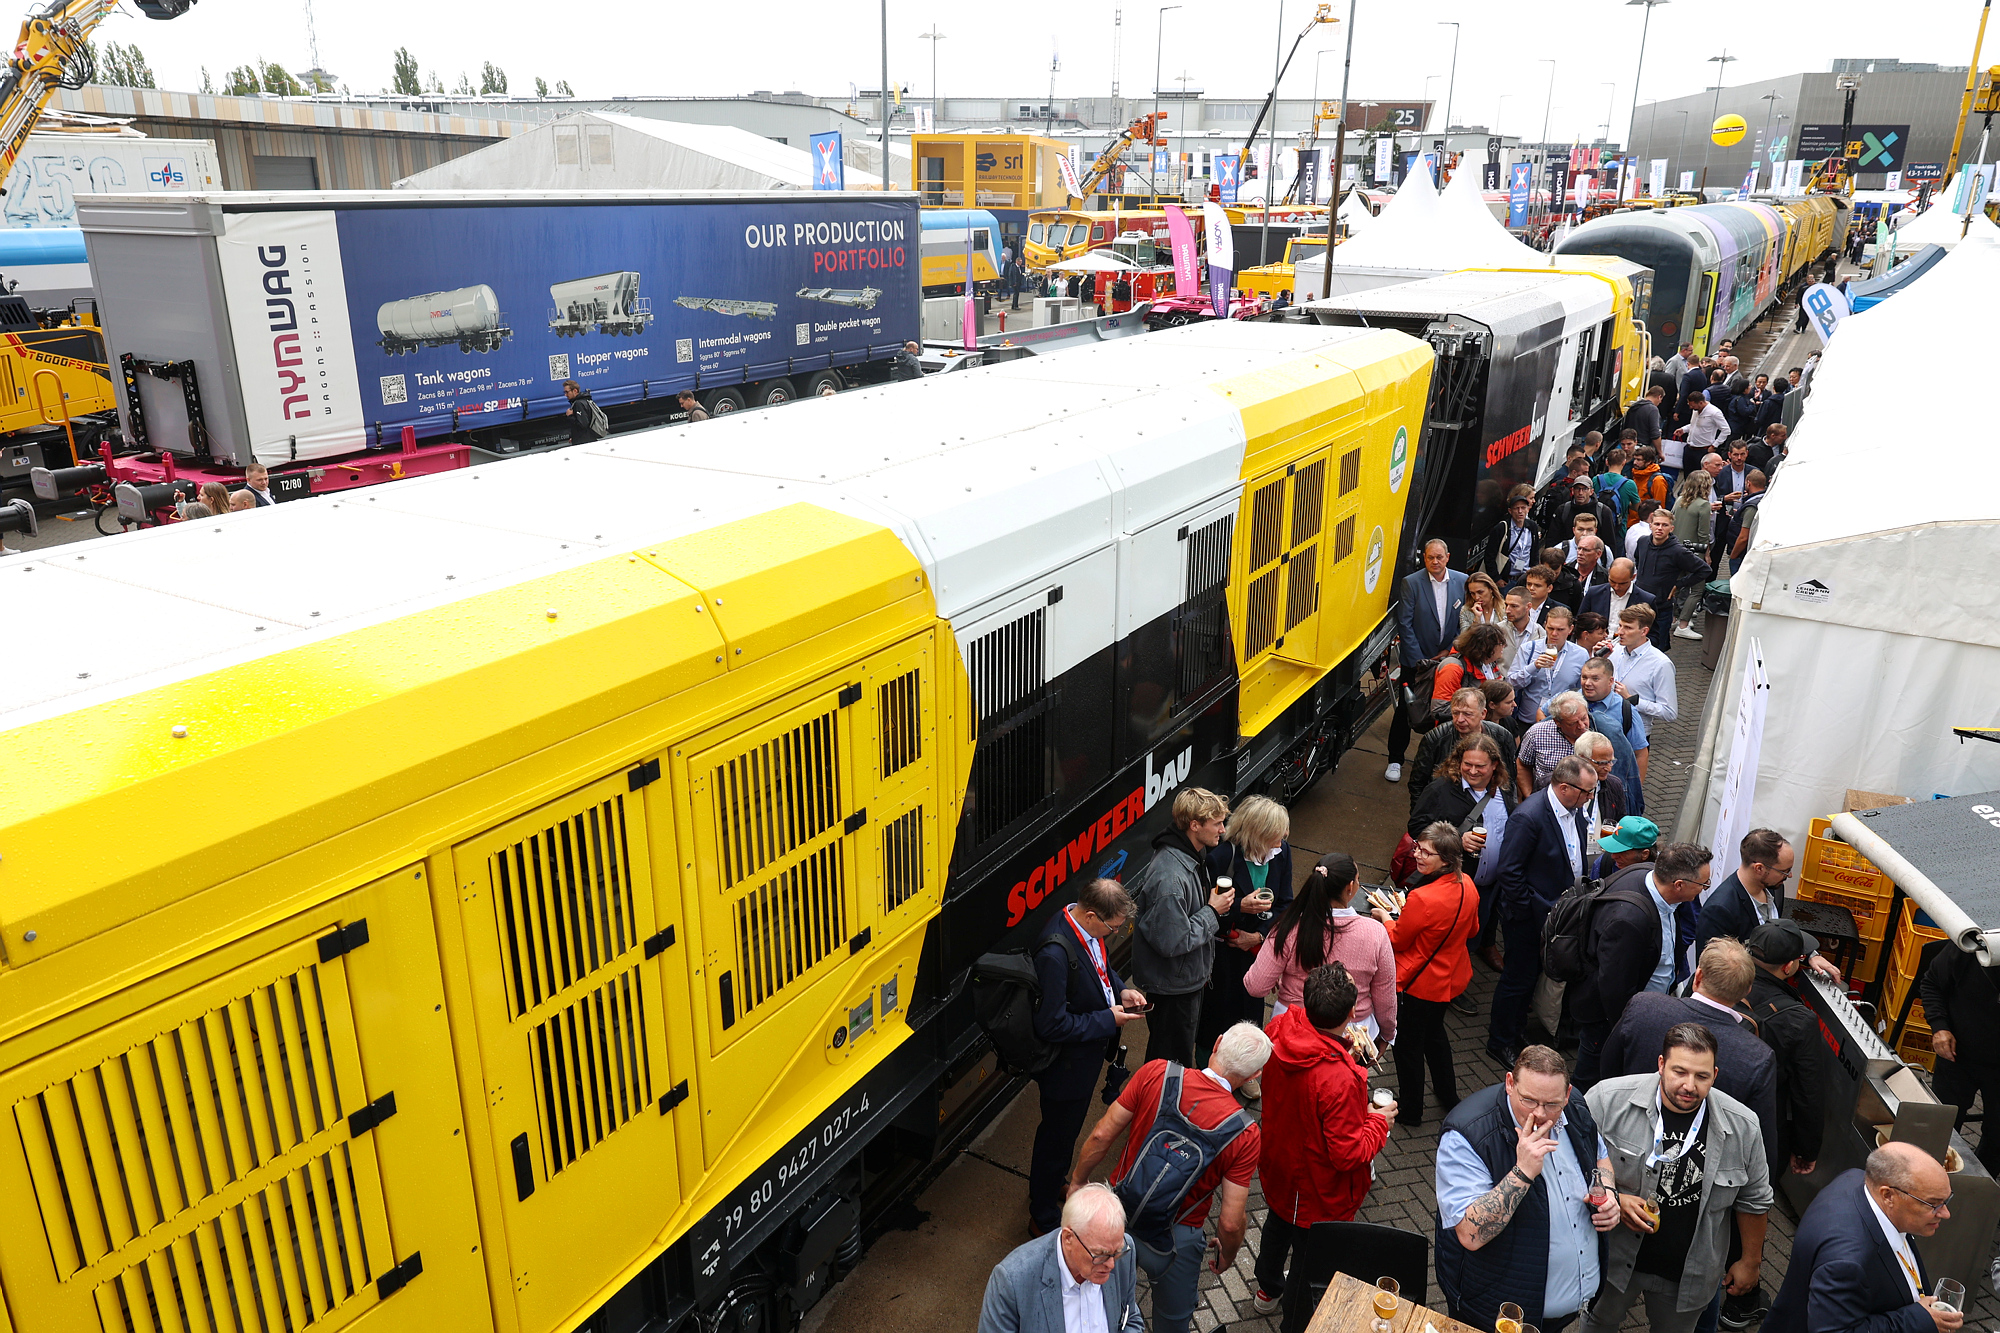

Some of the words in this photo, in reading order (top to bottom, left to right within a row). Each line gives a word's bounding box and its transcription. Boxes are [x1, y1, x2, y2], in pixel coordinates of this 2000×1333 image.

[1395, 110, 1414, 125] 25
[151, 162, 183, 187] CHS
[745, 224, 787, 248] OUR
[794, 220, 904, 246] PRODUCTION
[814, 246, 905, 273] PORTFOLIO
[300, 244, 318, 323] PASSION
[815, 321, 837, 332] Double
[839, 318, 860, 332] pocket
[861, 317, 880, 328] wagon
[699, 332, 741, 348] Intermodal
[743, 331, 771, 344] wagons
[577, 352, 611, 366] Hopper
[614, 348, 648, 360] wagons
[316, 346, 332, 414] WAGONS
[415, 370, 444, 386] Tank
[447, 367, 491, 383] wagons
[578, 369, 595, 377] Faccns
[437, 390, 445, 398] 88
[459, 386, 476, 395] Zacns
[498, 380, 518, 389] Zacens
[419, 405, 434, 413] Zags
[280, 478, 302, 491] T2/80
[1902, 1052, 1928, 1063] Coke
[750, 1180, 772, 1213] 80
[778, 1137, 817, 1188] 9427
[824, 1092, 869, 1147] 027-4
